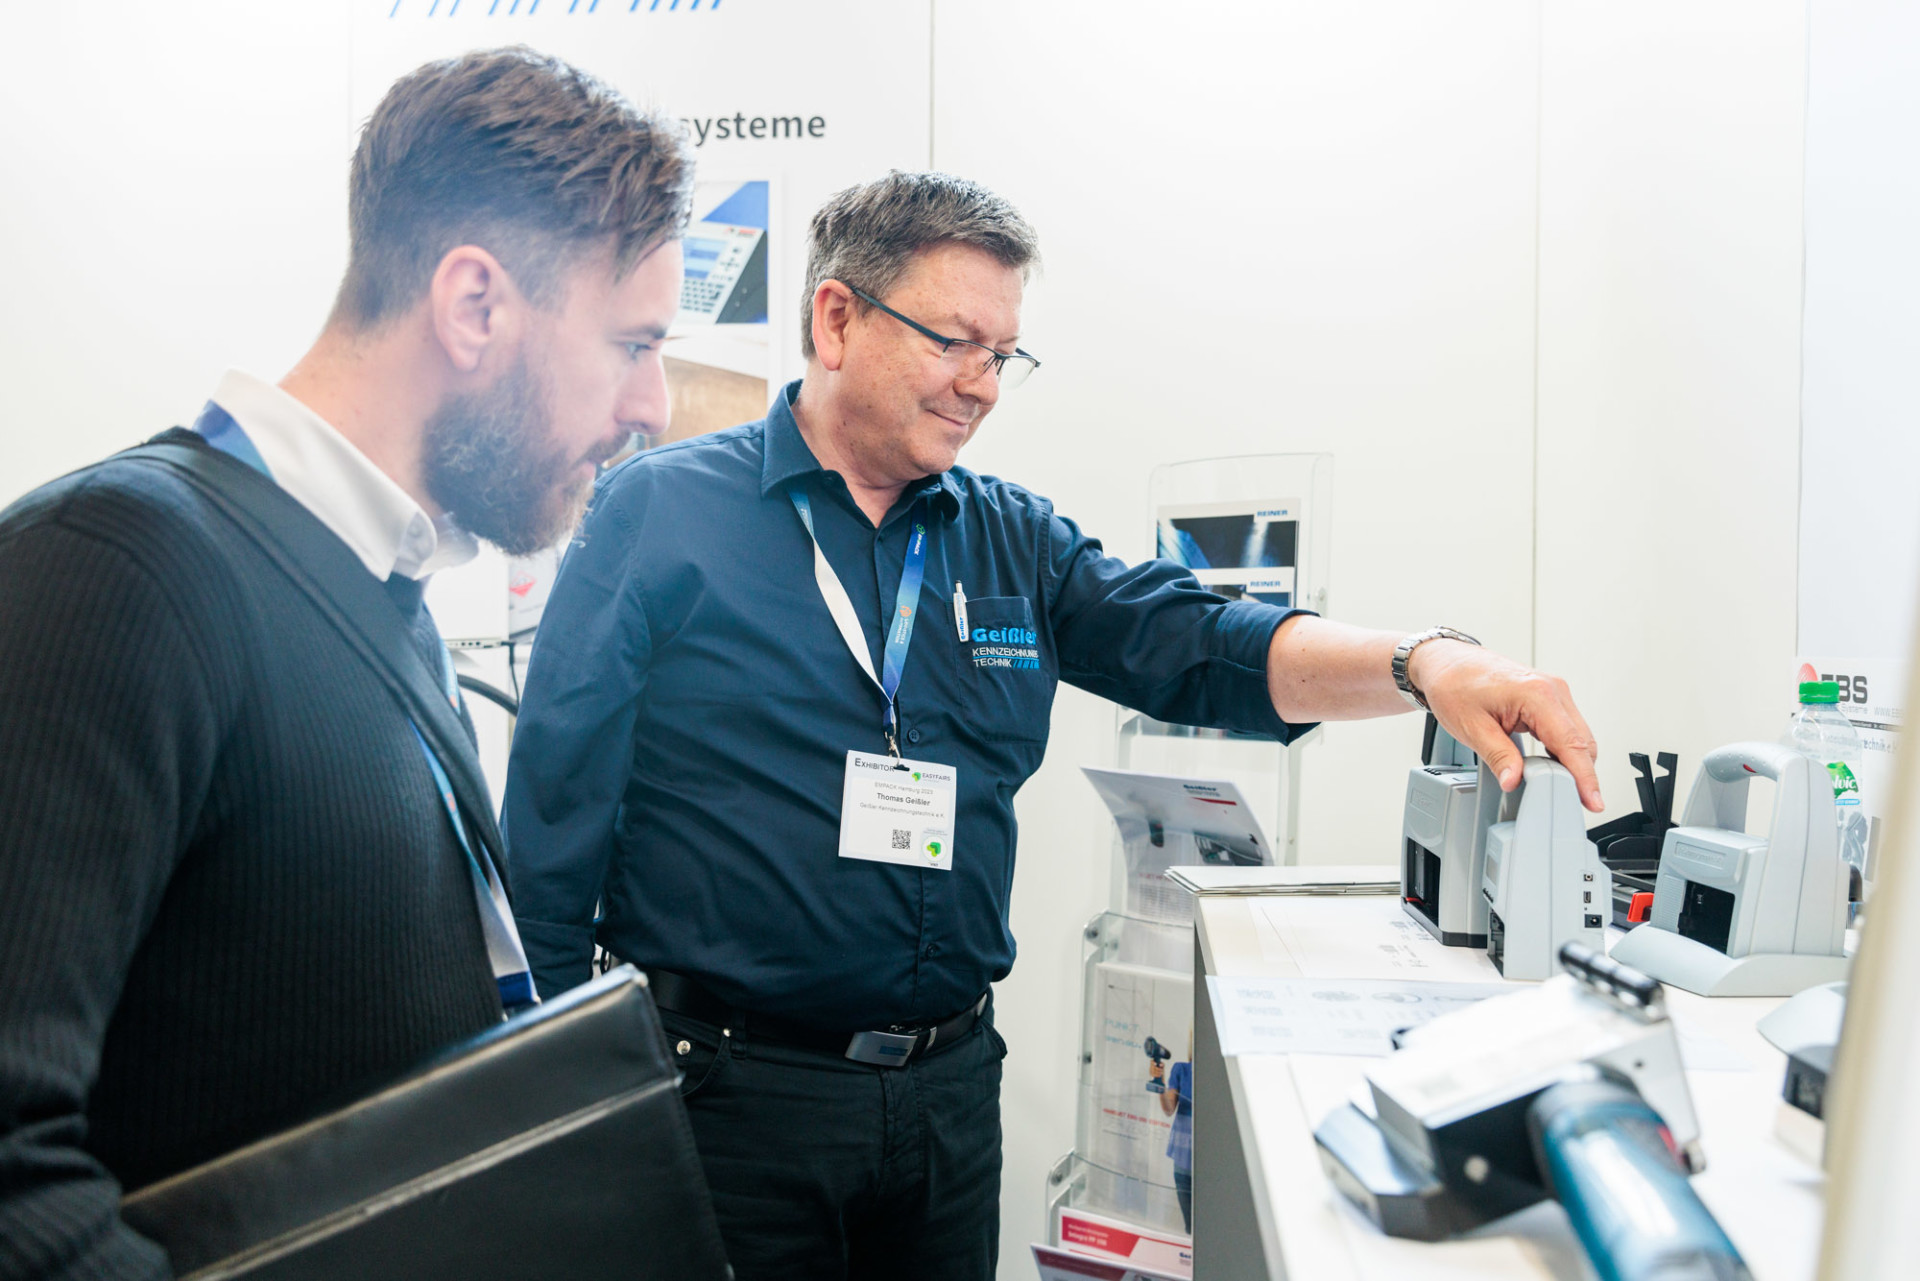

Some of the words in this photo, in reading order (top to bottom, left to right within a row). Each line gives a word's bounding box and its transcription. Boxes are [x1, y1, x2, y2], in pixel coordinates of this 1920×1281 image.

[1257, 509, 1288, 517] REINER
[972, 627, 1037, 645] Geißler
[973, 658, 1012, 668] TECHNIK
[854, 757, 894, 772] EXHIBITOR
[922, 773, 951, 782] EASYFAIRS
[877, 793, 904, 802] Thomas
[905, 796, 931, 806] Geißler
